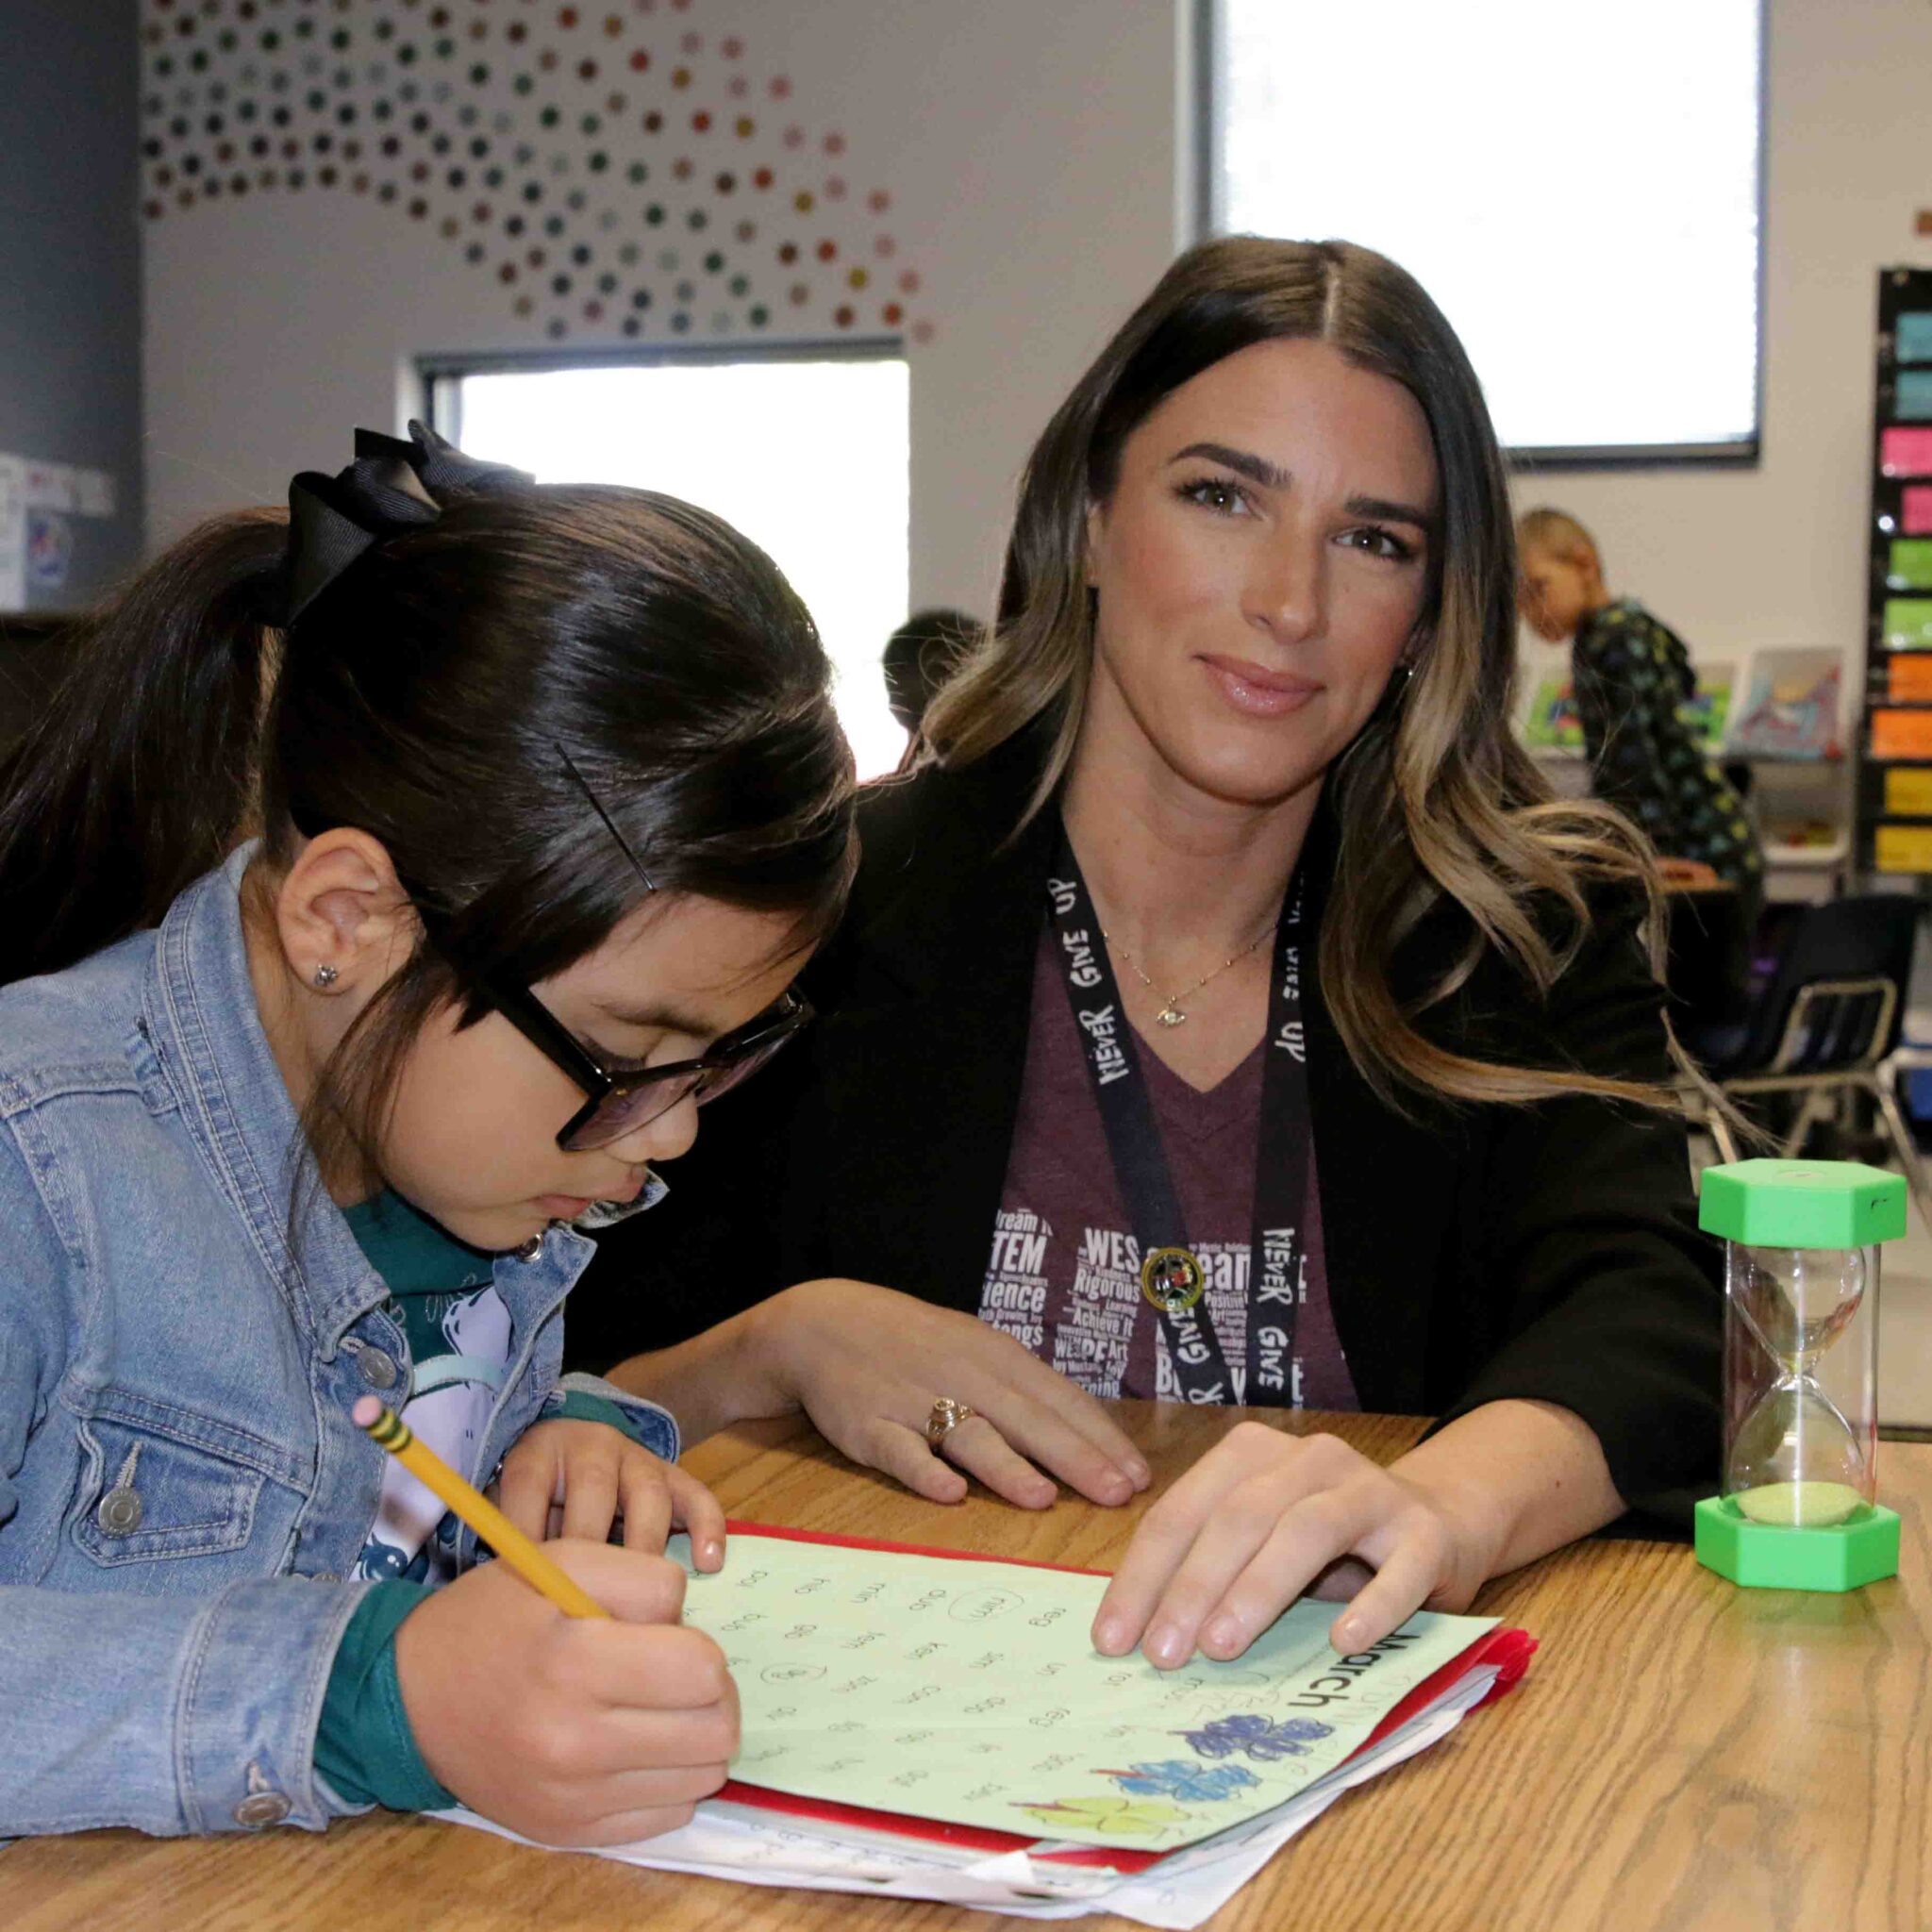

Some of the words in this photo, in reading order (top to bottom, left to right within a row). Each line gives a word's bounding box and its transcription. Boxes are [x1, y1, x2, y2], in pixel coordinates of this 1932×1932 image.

[1047, 878, 1076, 914] UP
[1063, 929, 1102, 988] GIVE
[1079, 1005, 1129, 1085] NEVER
[1274, 1022, 1306, 1062] UP
[991, 1231, 1047, 1274] TEM
[1085, 1227, 1141, 1274] WES
[1256, 1227, 1295, 1305] NEVER
[982, 1281, 1046, 1313] ience
[1074, 1268, 1141, 1304] Rigorous
[1073, 1307, 1120, 1334] Achieve
[1169, 1307, 1210, 1364] GIVE
[1257, 1326, 1290, 1391] GIVE
[1288, 1631, 1421, 1707] March
